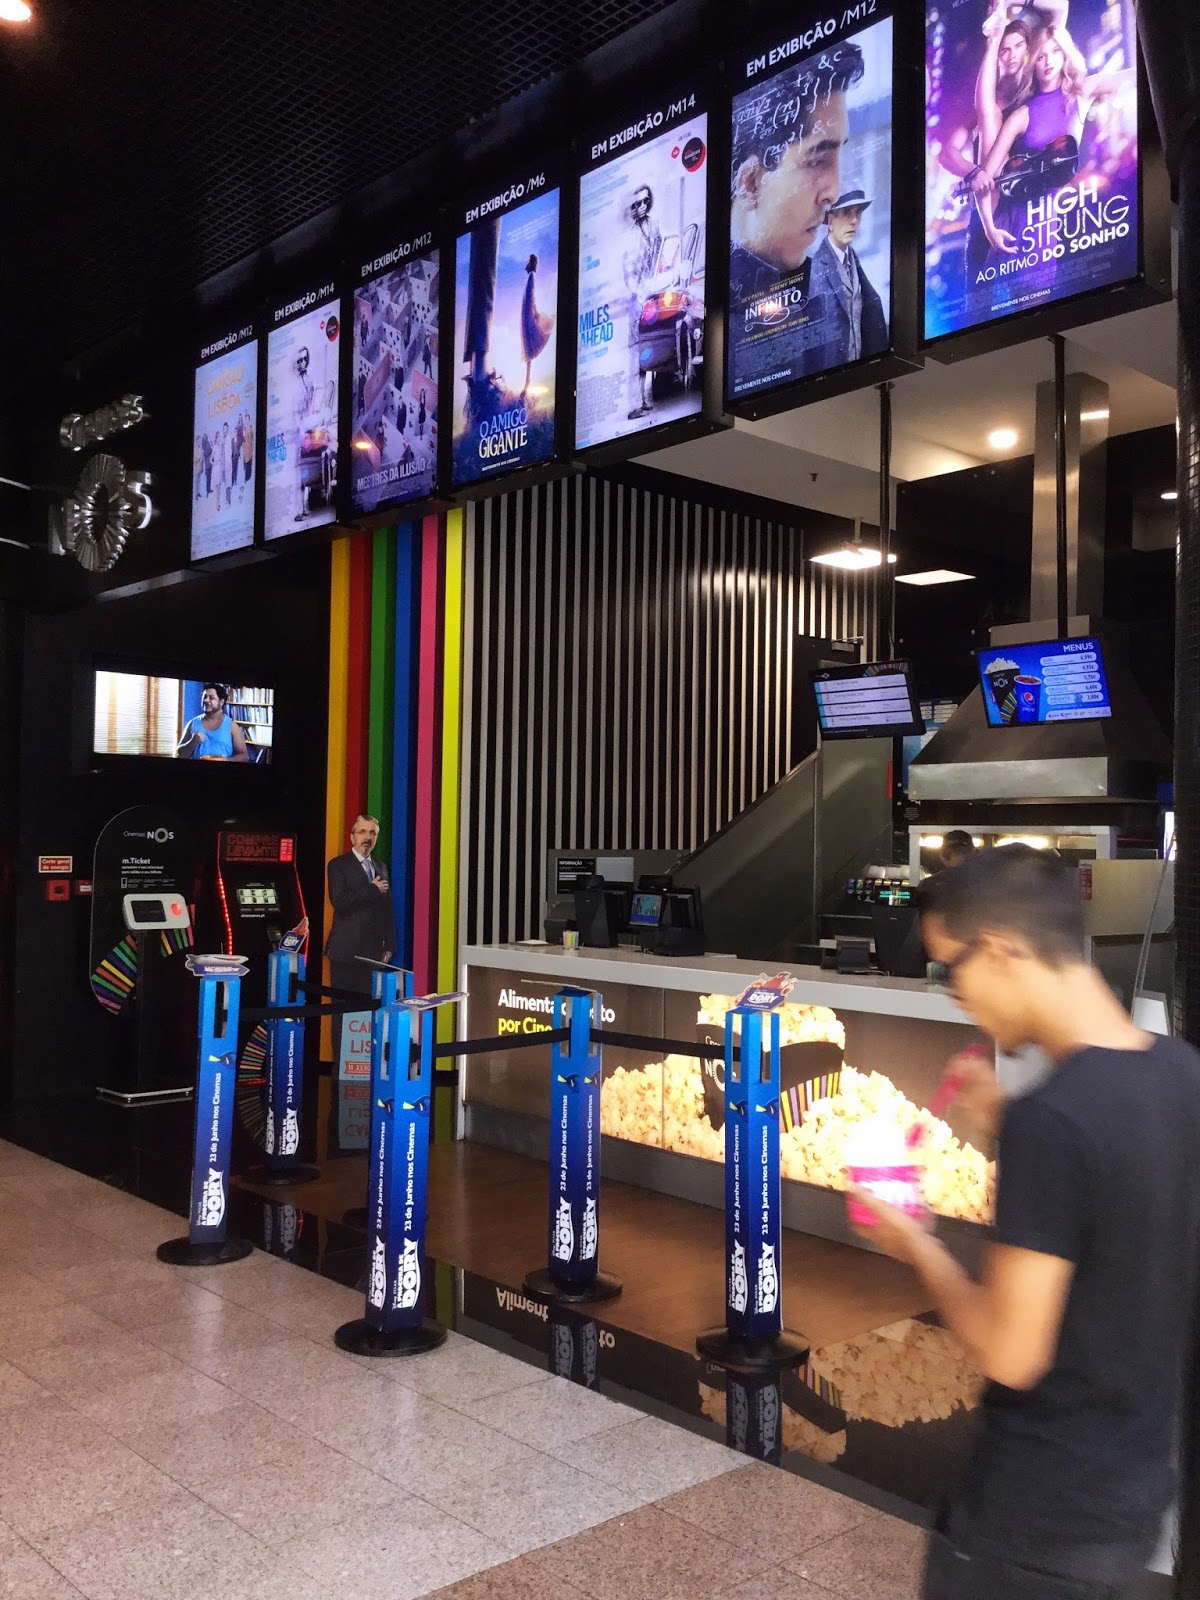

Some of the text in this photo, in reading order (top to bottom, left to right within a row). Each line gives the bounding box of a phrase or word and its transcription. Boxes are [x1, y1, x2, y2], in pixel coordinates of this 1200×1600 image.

[746, 0, 877, 78] EM EXIBIÇÃO /M12
[591, 93, 696, 160] EM EXIBIÇÃO /M14
[465, 172, 546, 224] EM EXIBIÇÃO /M6
[1027, 176, 1098, 226] HIGH
[1021, 195, 1130, 253] STRUNG
[361, 231, 432, 278] EM EXIBIÇÃO /M12
[975, 267, 997, 285] AO
[999, 253, 1039, 277] RITMO
[1042, 244, 1065, 263] DO
[1069, 223, 1130, 253] SONHO
[274, 282, 335, 321] EM EXIBIÇÃO /M14
[744, 289, 802, 321] INFINITO
[580, 304, 610, 333] MILES
[201, 324, 253, 359] EM EXIBIÇÃO /M12
[580, 322, 614, 348] AHEAD
[480, 407, 528, 438] O AMIGO
[479, 425, 528, 459] GIGANTE
[357, 469, 389, 492] MESTRES
[389, 466, 400, 482] DA
[399, 457, 426, 479] ILUSÃO
[1063, 642, 1094, 653] MENUS
[146, 827, 175, 844] NOS
[121, 857, 151, 865] m.Ticket
[498, 1017, 520, 1035] por
[213, 1073, 221, 1105] Cinemas
[286, 1088, 293, 1096] de
[210, 1119, 220, 1142] Junho
[285, 1107, 297, 1155] DORY
[406, 1122, 416, 1160] Cinemas
[209, 1154, 217, 1163] 23
[210, 1143, 218, 1153] de
[560, 1145, 568, 1170] Junho
[559, 1181, 567, 1191] 23
[560, 1170, 567, 1180] de
[586, 1169, 592, 1180] de
[586, 1181, 592, 1191] 23
[760, 1125, 770, 1235] 23 de Junho nos Cinemas
[206, 1168, 222, 1227] DORY
[377, 1177, 385, 1206] Junho
[405, 1178, 415, 1206] Junho
[734, 1180, 742, 1209] Junho
[376, 1207, 382, 1218] de
[376, 1218, 382, 1229] 23
[404, 1207, 412, 1219] de
[404, 1220, 412, 1231] 23
[734, 1210, 740, 1221] de
[734, 1222, 740, 1233] 23
[558, 1196, 572, 1261] DORY
[586, 1196, 596, 1260] DORY
[373, 1235, 385, 1309] DORY
[402, 1237, 418, 1309] DORY
[734, 1239, 746, 1313] DORY
[761, 1242, 775, 1314] DORY
